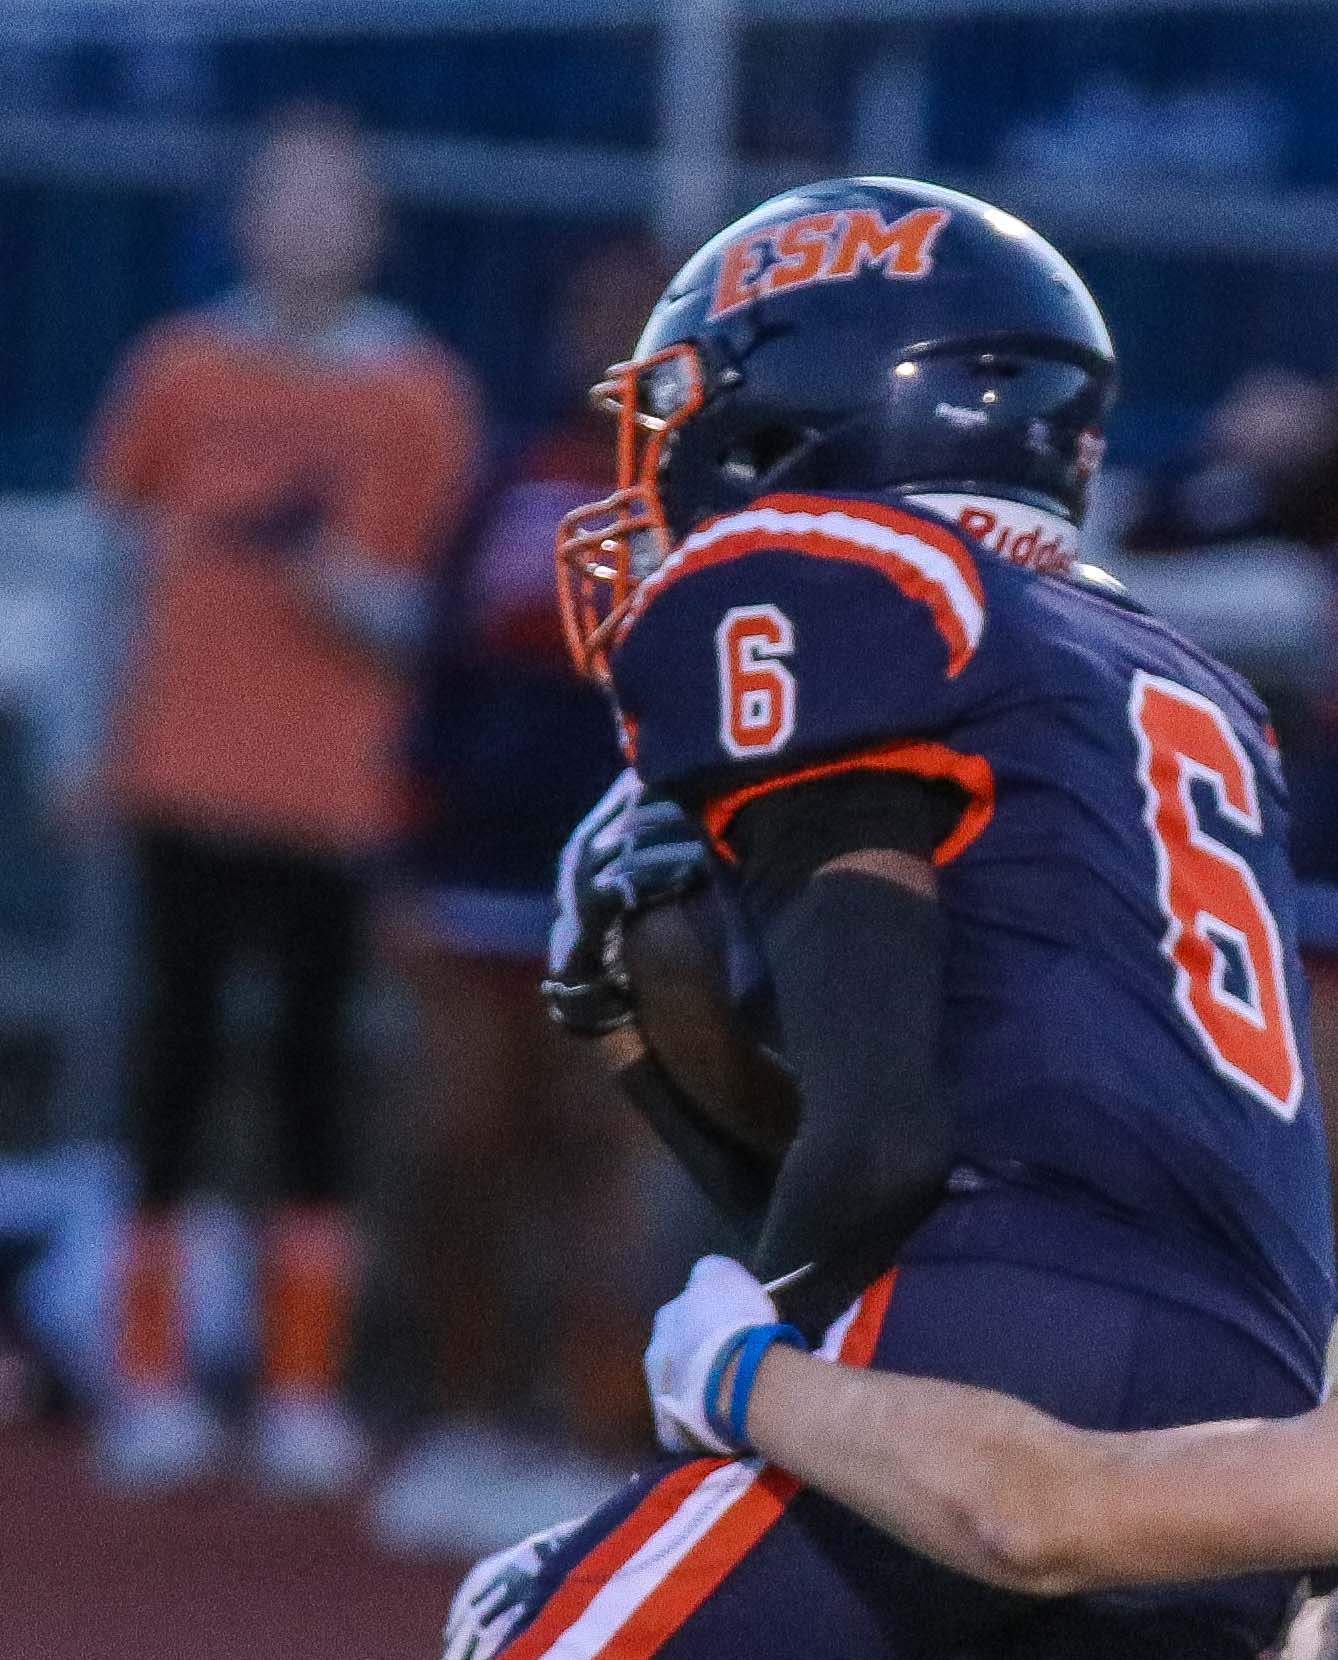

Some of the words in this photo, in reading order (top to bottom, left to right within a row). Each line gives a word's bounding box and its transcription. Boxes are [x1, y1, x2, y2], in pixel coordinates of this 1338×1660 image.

[705, 207, 950, 320] ESM
[716, 604, 796, 759] 6
[1130, 668, 1303, 1122] 6
